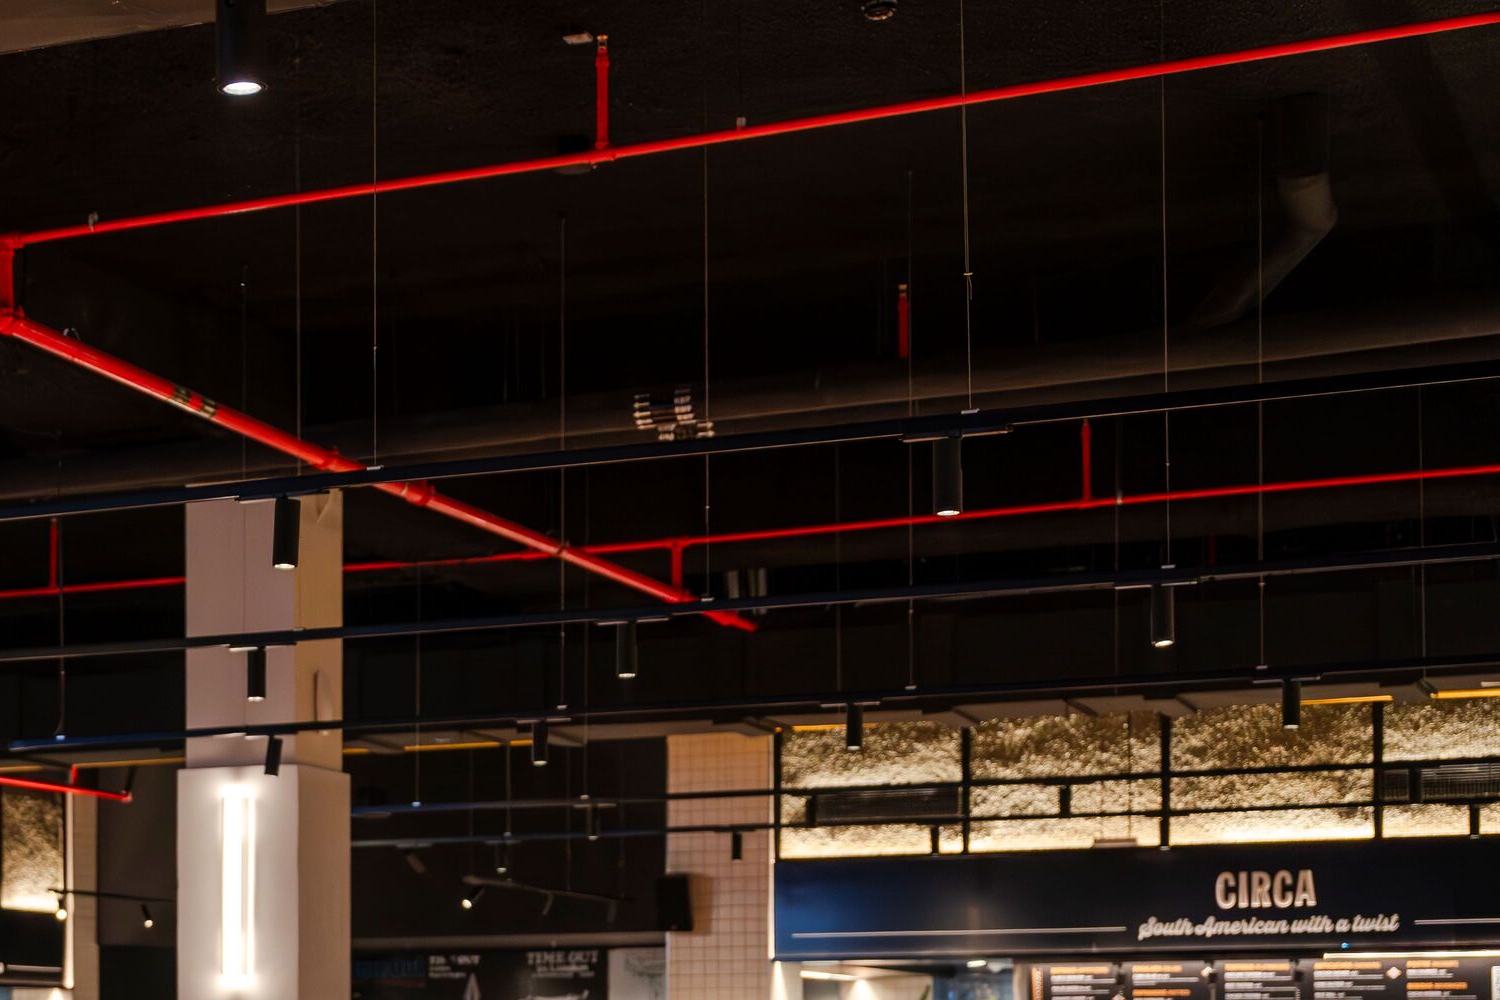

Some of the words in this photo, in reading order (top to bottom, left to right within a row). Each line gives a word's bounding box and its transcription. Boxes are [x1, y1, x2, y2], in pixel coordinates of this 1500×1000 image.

[1214, 868, 1318, 910] CIRCA
[1138, 915, 1194, 941] South
[1194, 914, 1288, 938] American
[1290, 914, 1334, 933] with
[1335, 920, 1351, 932] a
[1351, 912, 1400, 932] twist
